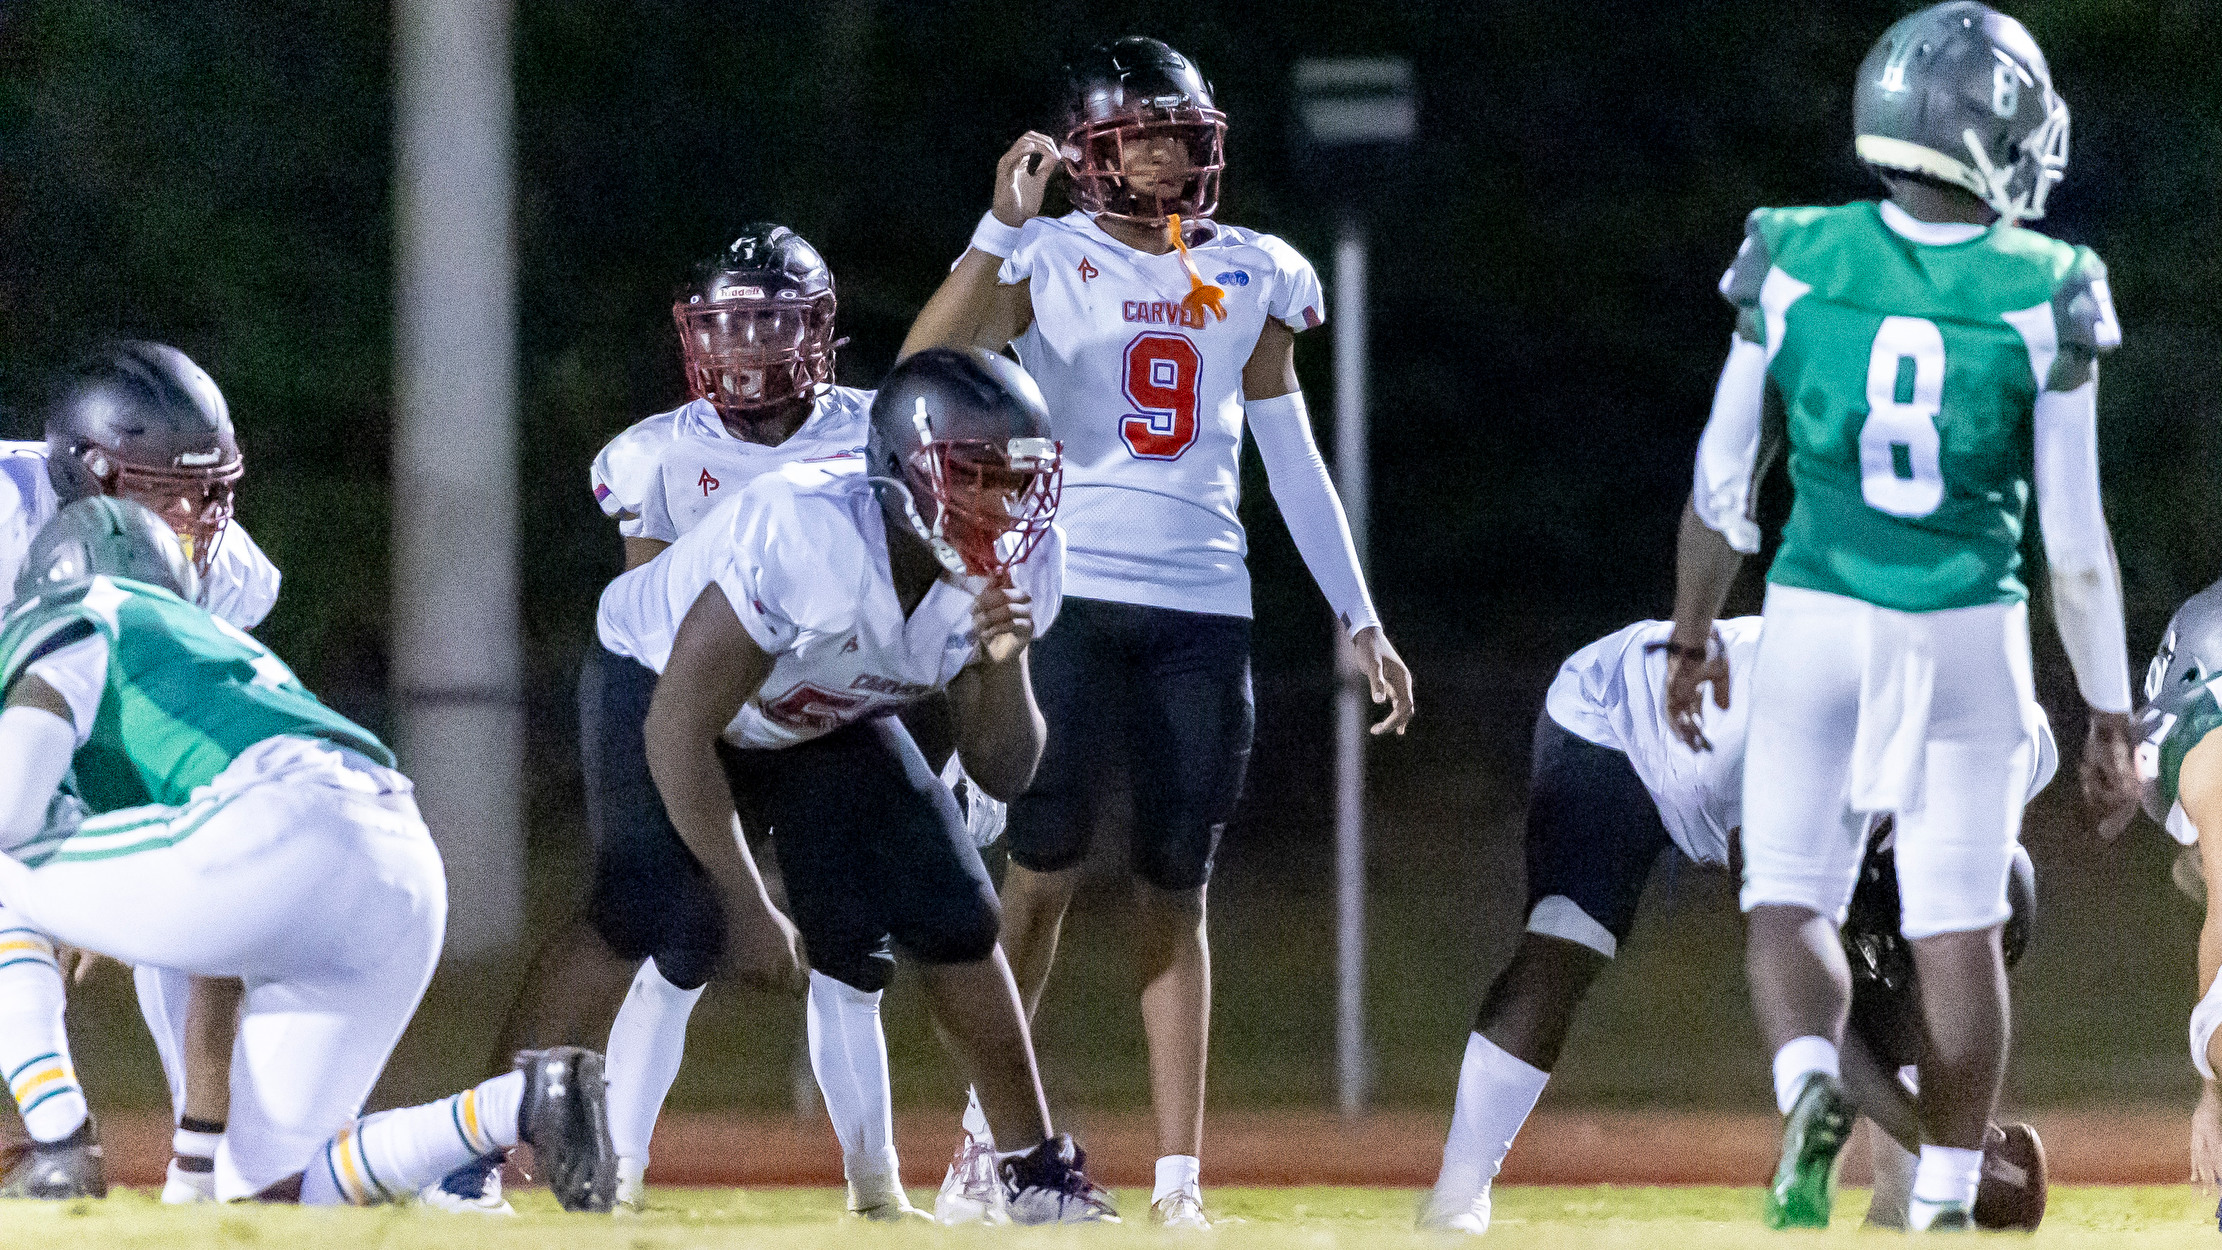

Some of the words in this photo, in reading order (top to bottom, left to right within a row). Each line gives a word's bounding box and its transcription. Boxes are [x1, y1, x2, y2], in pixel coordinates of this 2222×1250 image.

[1992, 63, 2019, 119] 8
[1122, 300, 1206, 328] CARV
[1118, 330, 1203, 462] 9
[1859, 315, 1946, 519] 8
